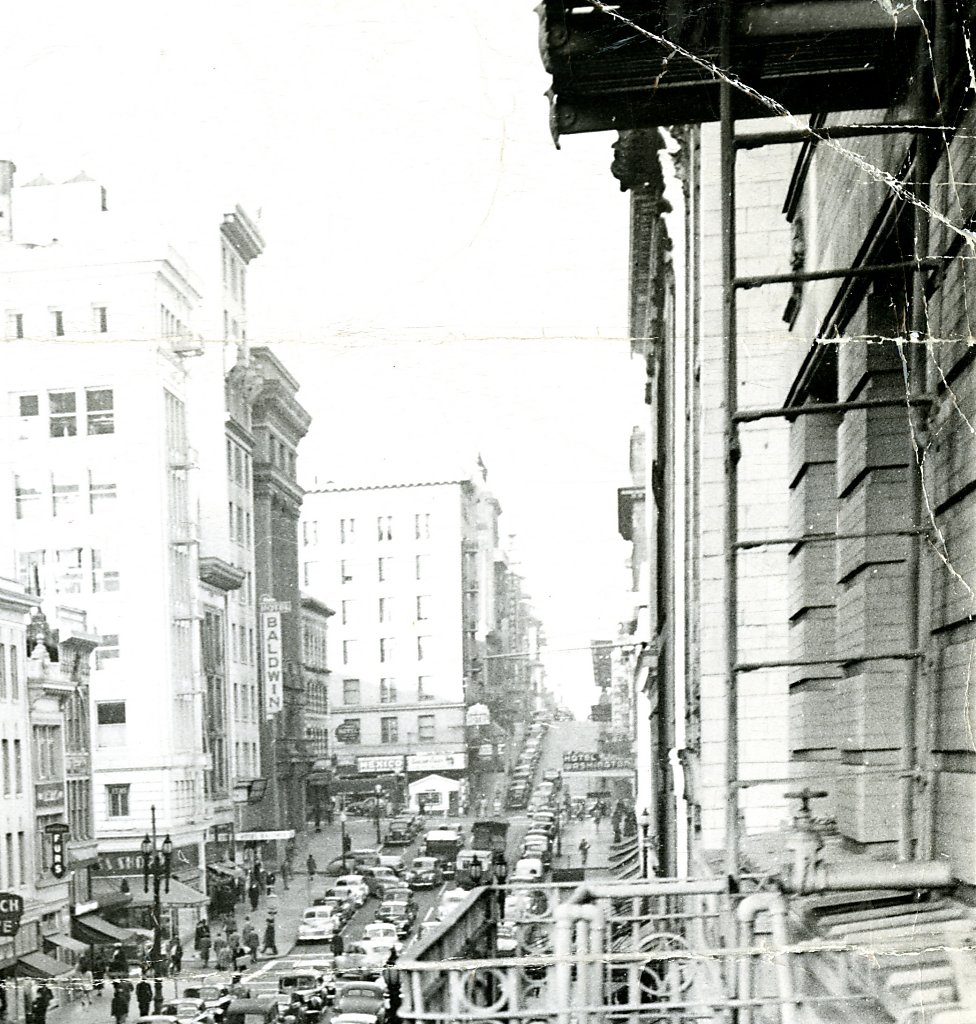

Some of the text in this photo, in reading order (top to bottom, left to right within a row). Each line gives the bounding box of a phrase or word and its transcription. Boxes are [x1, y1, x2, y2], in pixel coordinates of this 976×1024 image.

[266, 616, 280, 708] BALDWIN
[359, 760, 403, 769] MEXICO
[53, 834, 62, 874] FURS
